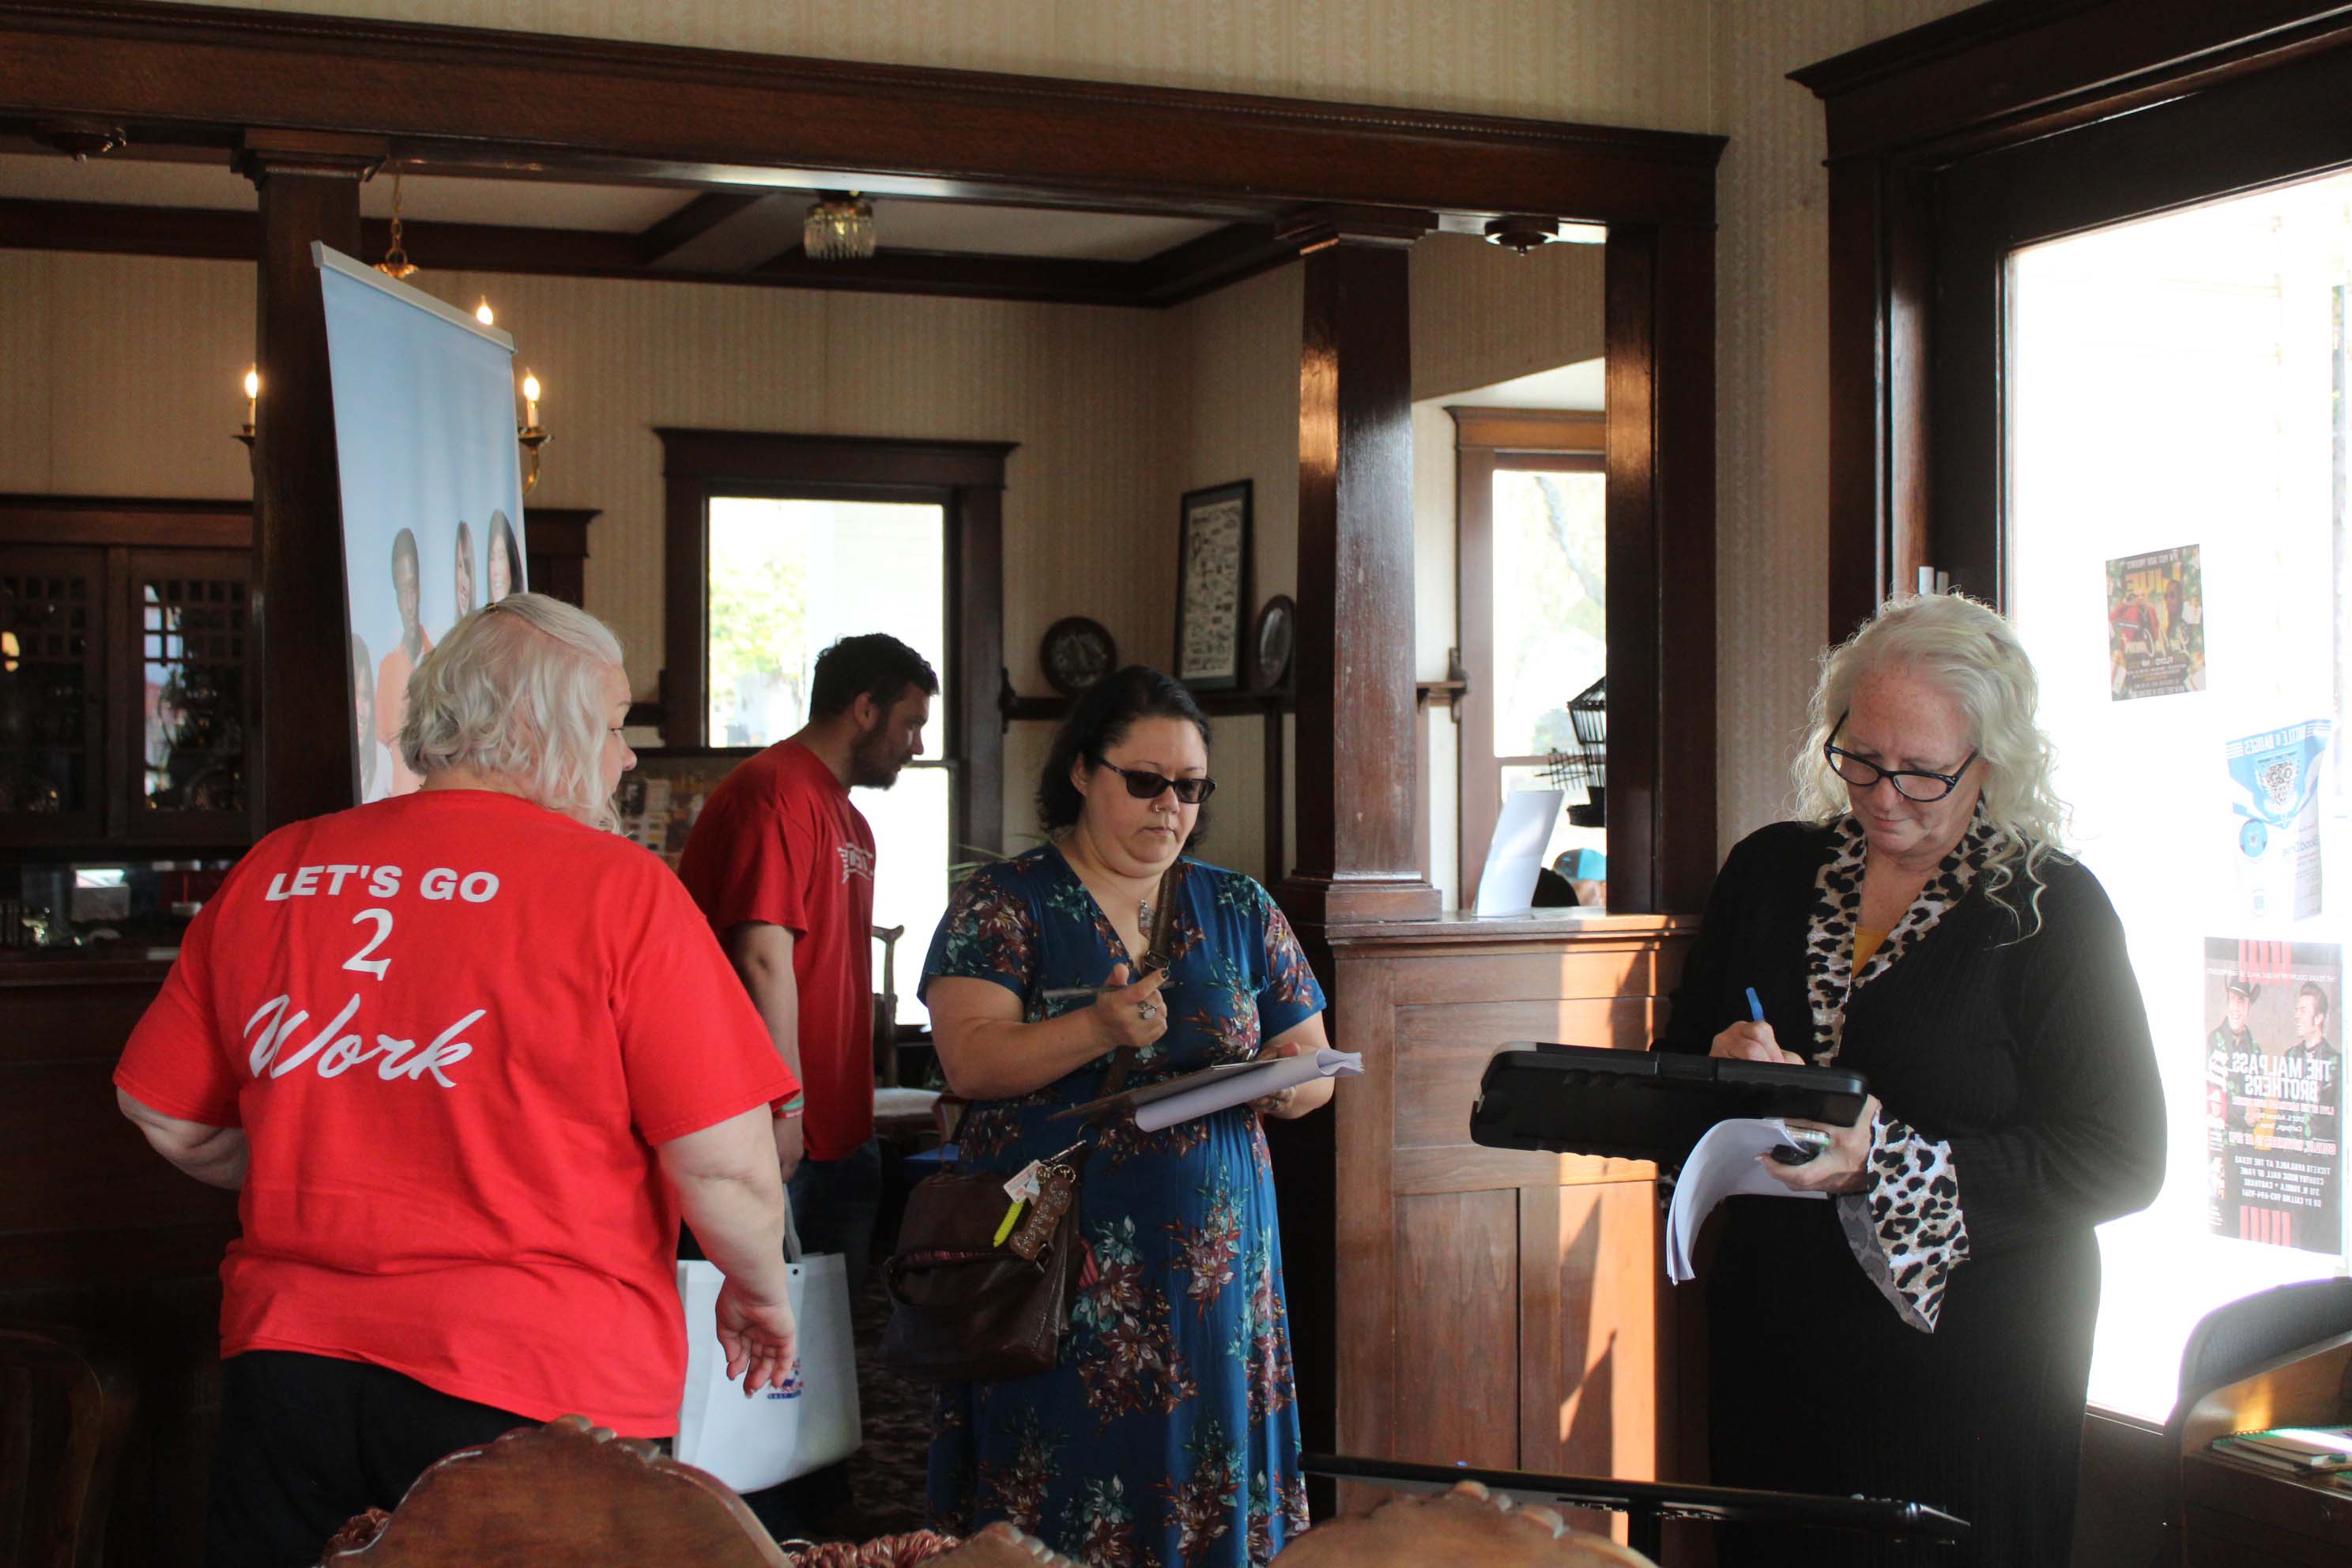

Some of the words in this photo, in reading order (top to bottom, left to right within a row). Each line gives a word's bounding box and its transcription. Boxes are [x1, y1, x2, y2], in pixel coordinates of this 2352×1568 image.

[265, 865, 402, 901] LET'S
[420, 868, 499, 903] GO
[342, 908, 393, 981] 2
[243, 993, 487, 1087] Work
